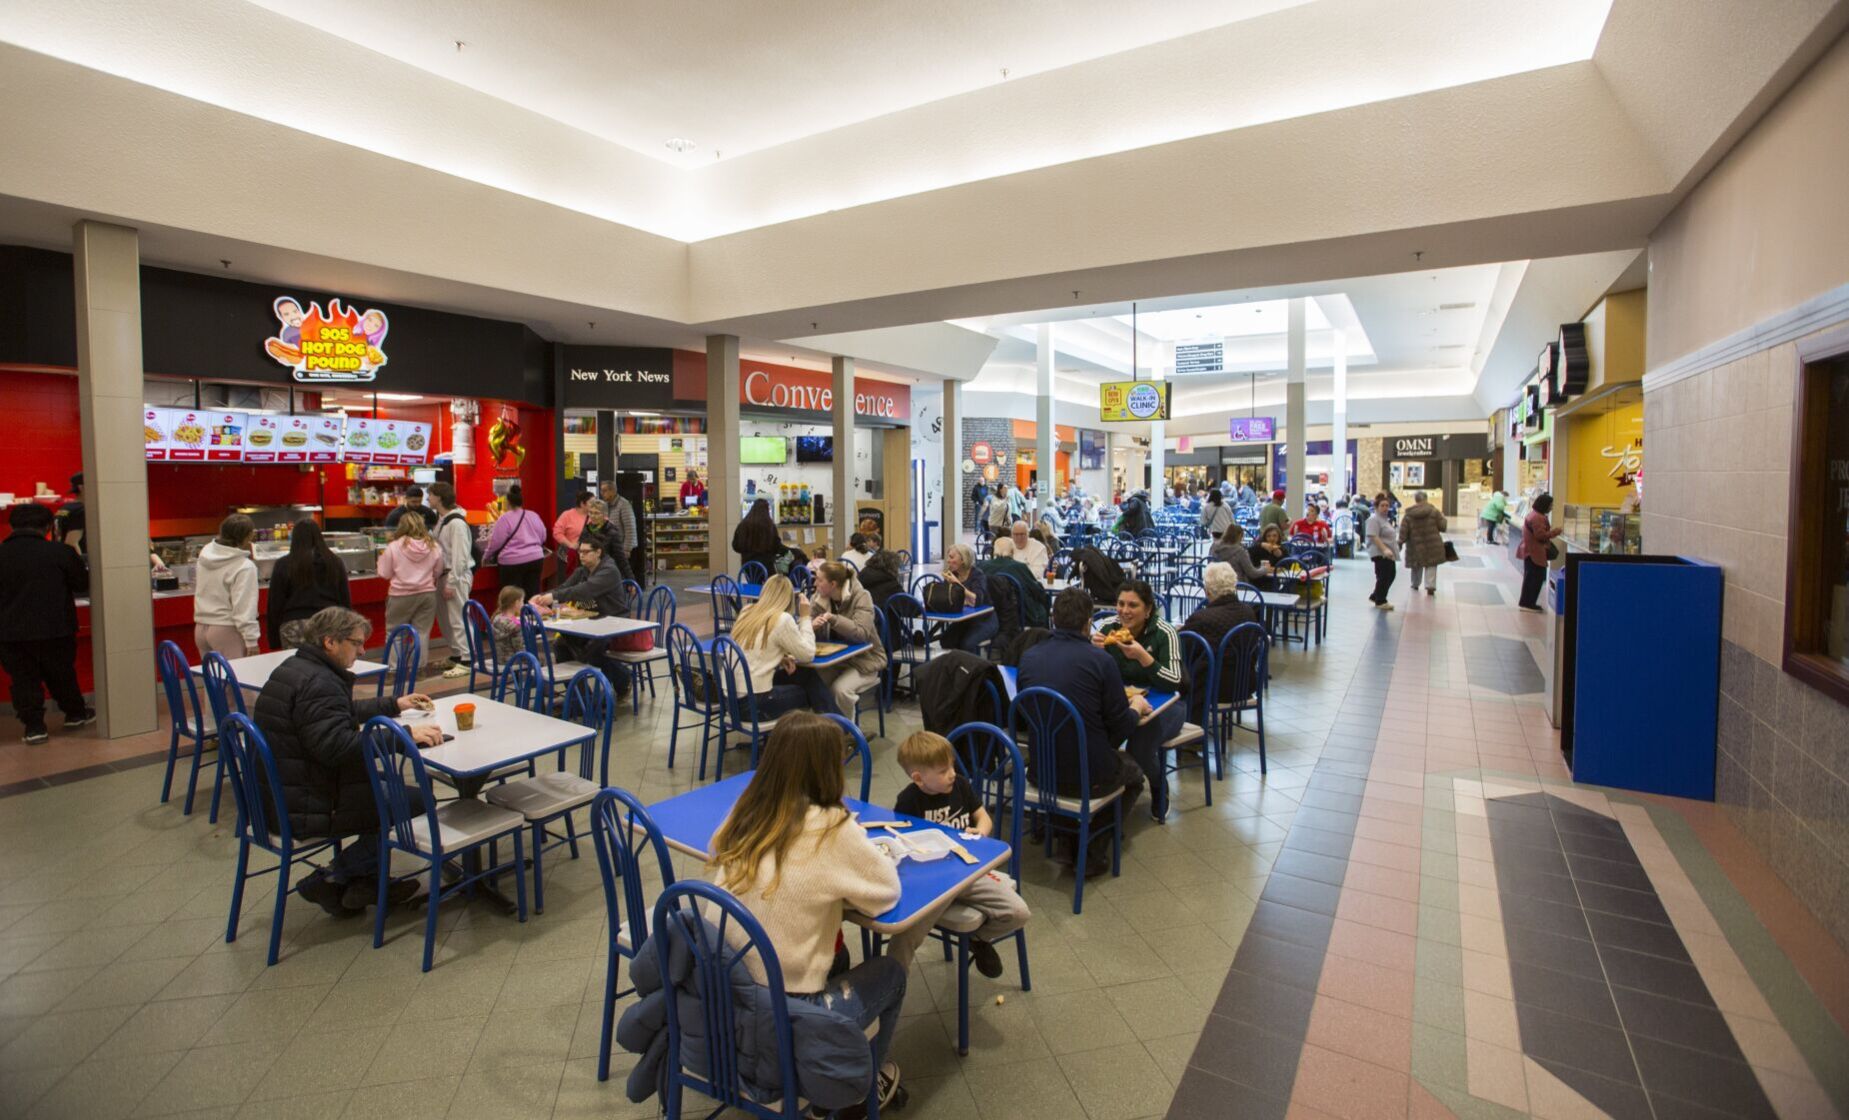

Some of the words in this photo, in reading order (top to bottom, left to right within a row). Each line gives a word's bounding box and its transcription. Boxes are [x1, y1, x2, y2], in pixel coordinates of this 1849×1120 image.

[320, 327, 349, 340] 905
[301, 341, 334, 355] HOT
[335, 342, 366, 356] DOG
[307, 356, 360, 369] POUND
[571, 369, 599, 381] New
[603, 369, 633, 382] York
[637, 370, 670, 383] News
[745, 371, 895, 417] Conveence
[1396, 438, 1432, 451] OMNI
